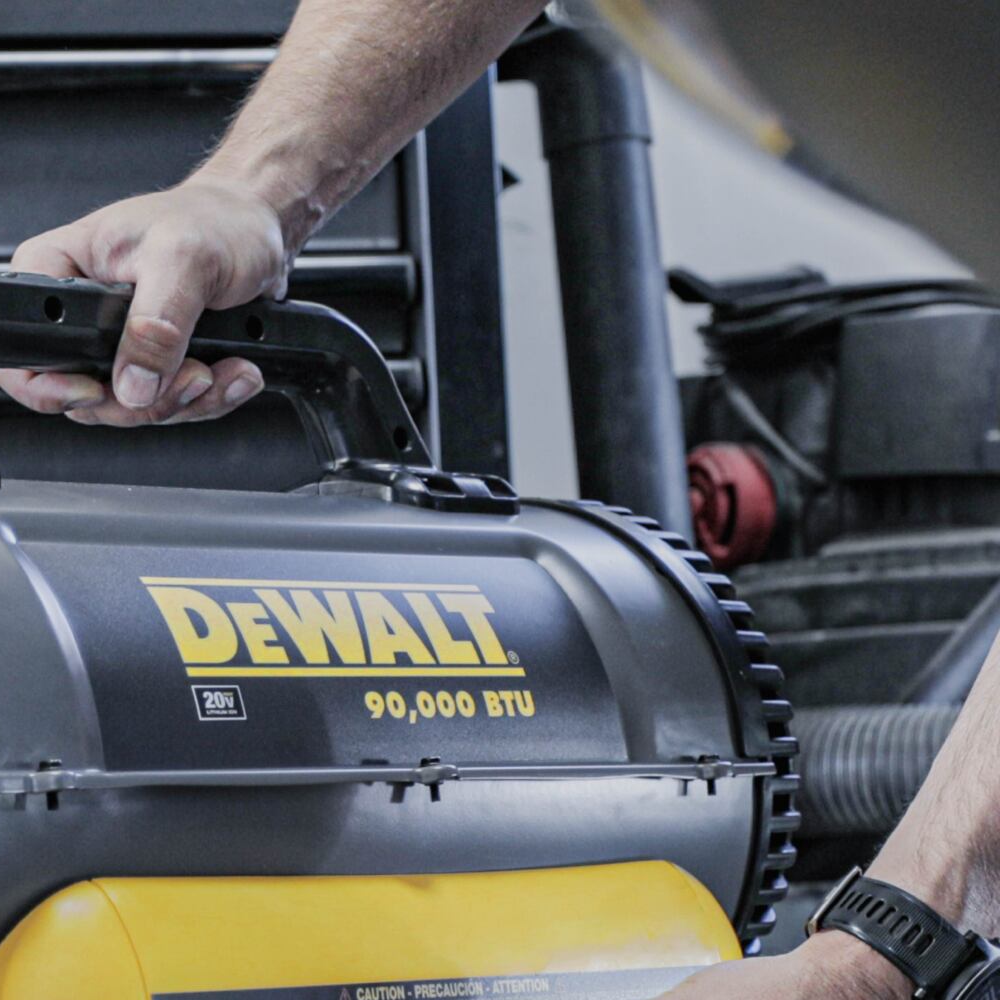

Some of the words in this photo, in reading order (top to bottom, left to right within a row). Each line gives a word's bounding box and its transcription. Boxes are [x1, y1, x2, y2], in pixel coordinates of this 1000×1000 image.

[364, 691, 476, 724] 90,000
[485, 691, 536, 719] BTU
[492, 978, 549, 995] ATTENTION
